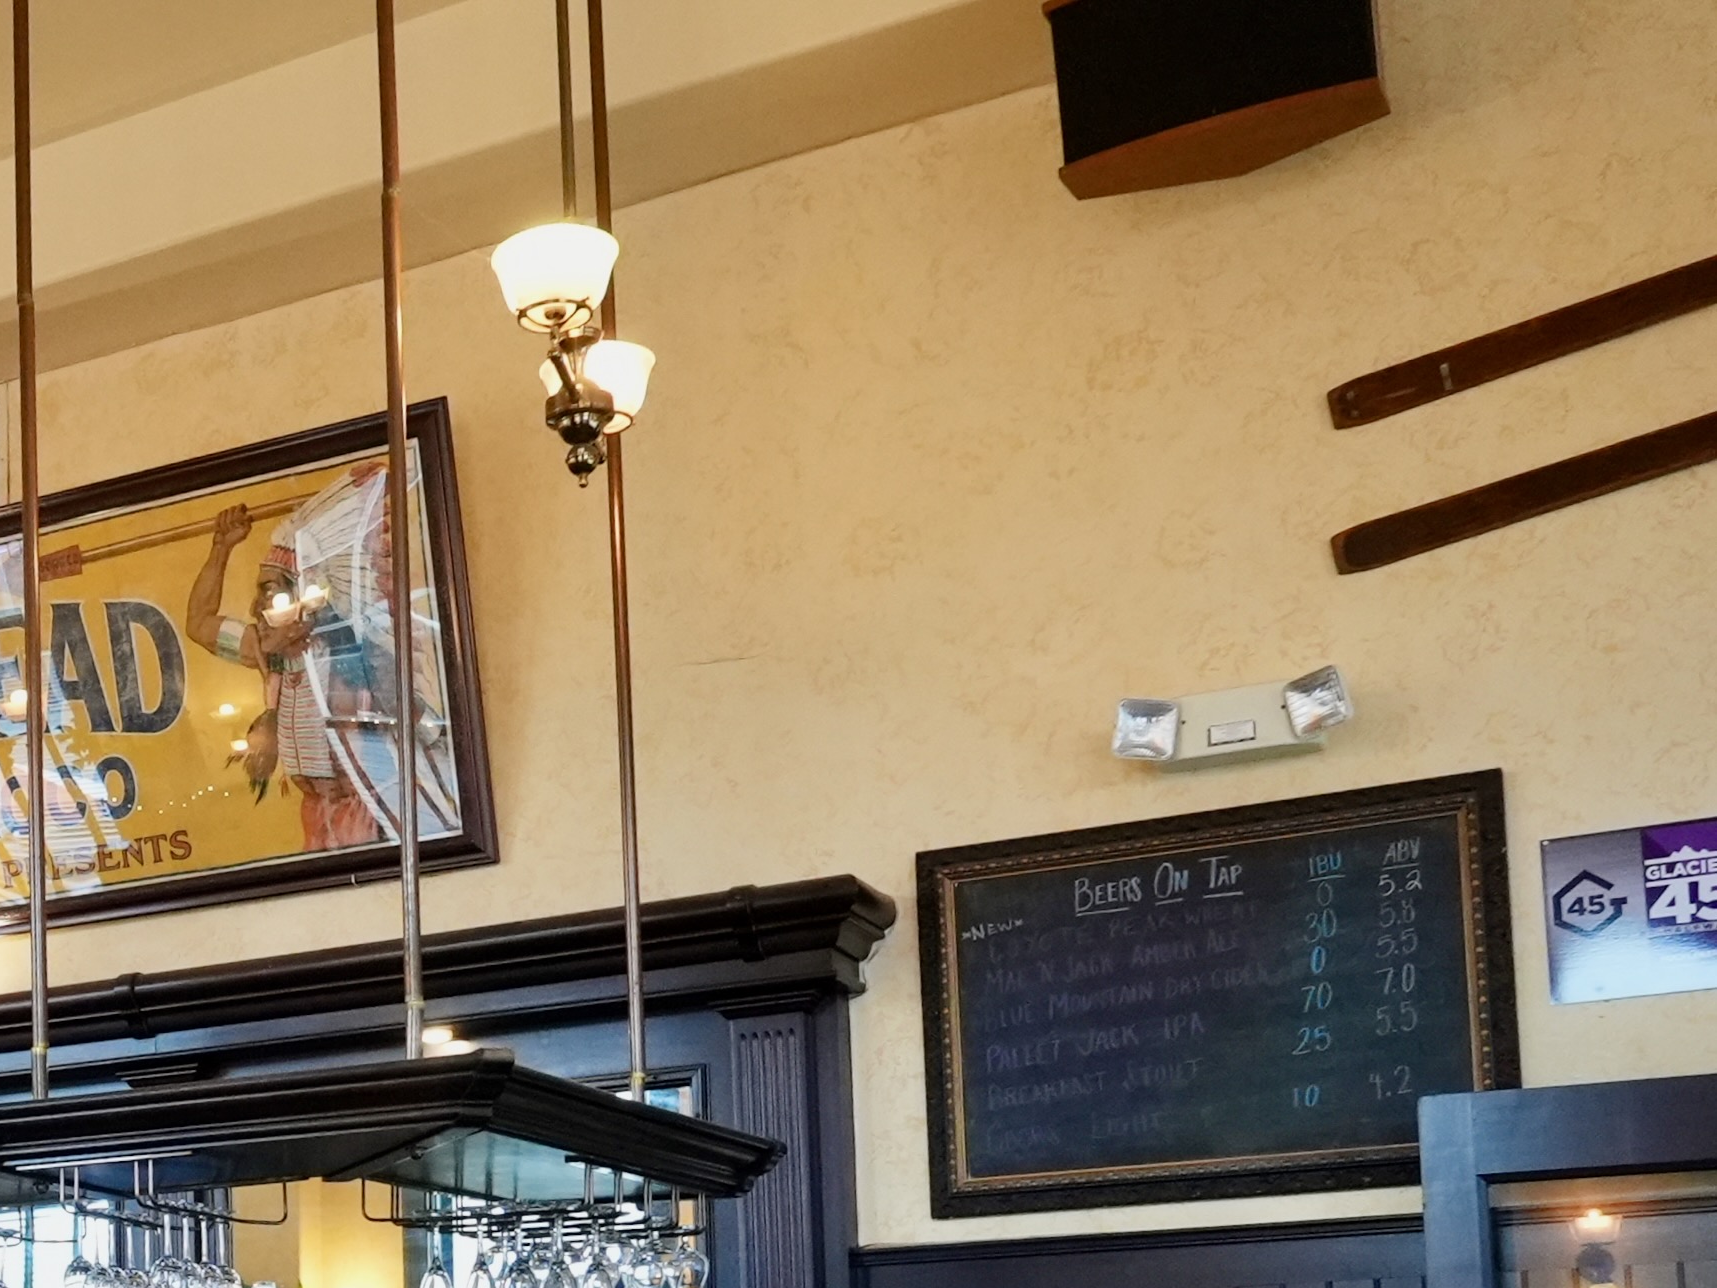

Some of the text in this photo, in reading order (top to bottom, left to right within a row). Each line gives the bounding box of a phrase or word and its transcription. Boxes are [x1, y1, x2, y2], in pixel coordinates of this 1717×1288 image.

[1, 830, 193, 889] PESENTS
[1308, 837, 1421, 877] IBU ABV
[1074, 856, 1244, 911] BEERS ON TAP
[1317, 881, 1333, 907] 0
[1378, 869, 1423, 897] 5.2
[1303, 908, 1338, 944] 30
[1567, 894, 1606, 917] 45
[1375, 927, 1419, 959] 5.5
[1076, 1023, 1140, 1057] JACK
[1163, 1011, 1206, 1041] IPA
[1301, 981, 1333, 1014] 70
[1374, 963, 1416, 995] 7.0
[1291, 1026, 1333, 1056] 25
[1375, 1000, 1419, 1037] 5.5
[1292, 1083, 1321, 1109] 10
[1369, 1065, 1413, 1101] 4.2
